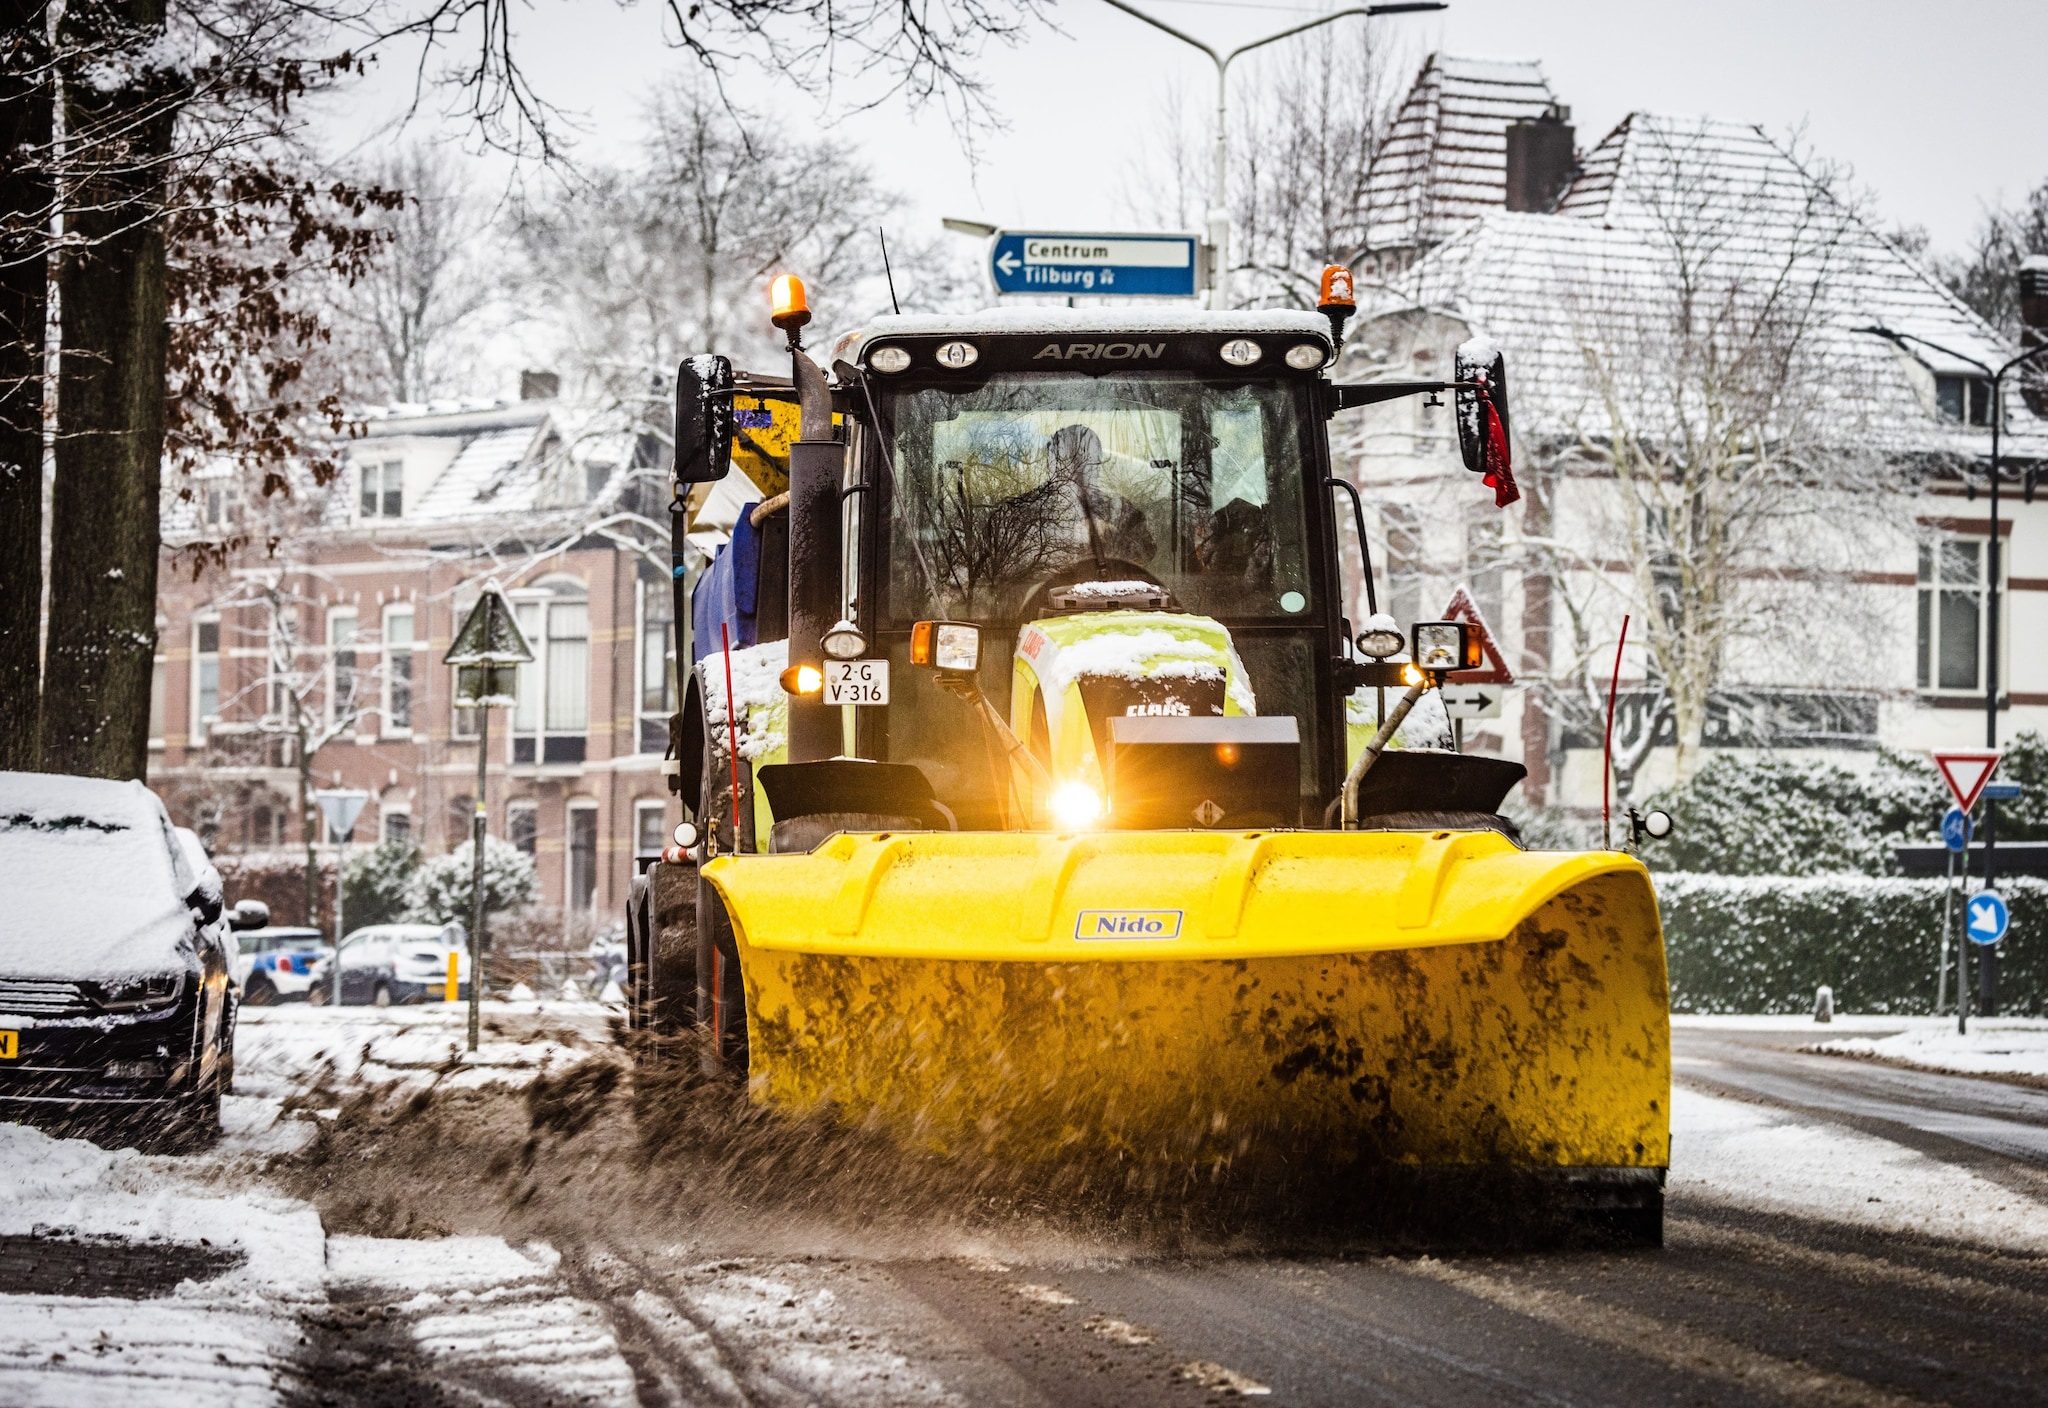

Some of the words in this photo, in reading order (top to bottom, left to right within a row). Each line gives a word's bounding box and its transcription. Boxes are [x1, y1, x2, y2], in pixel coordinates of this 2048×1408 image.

[1028, 242, 1108, 258] Centrum
[1024, 267, 1095, 288] Tilburg
[1033, 343, 1166, 360] ARION
[842, 664, 872, 681] 2-G
[831, 685, 881, 701] V-316
[1126, 704, 1191, 717] CLAAS
[1097, 916, 1163, 933] Nido
